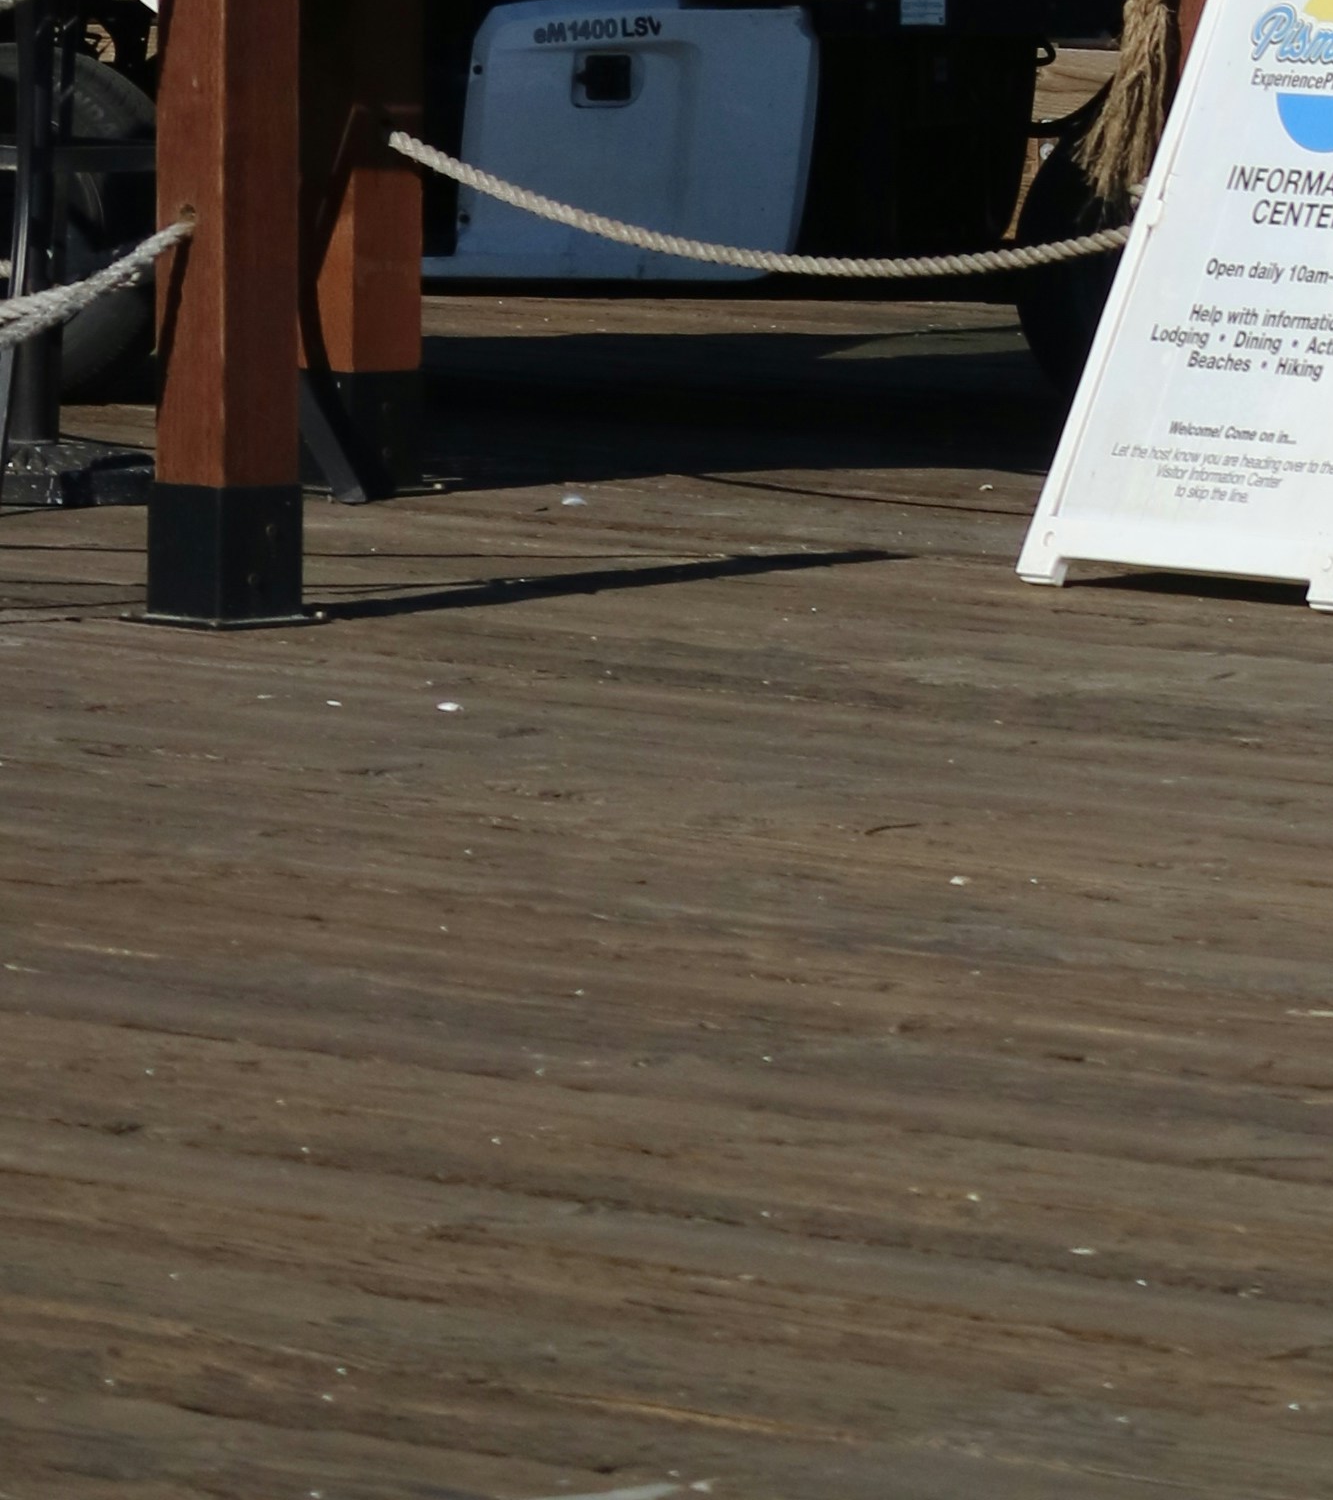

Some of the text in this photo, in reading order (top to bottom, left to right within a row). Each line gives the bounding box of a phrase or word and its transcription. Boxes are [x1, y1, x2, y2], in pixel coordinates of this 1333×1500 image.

[621, 15, 662, 38] LSV
[1206, 258, 1244, 280] Open
[1249, 261, 1285, 284] daily
[1189, 304, 1223, 325] Help
[1227, 307, 1259, 327] with
[1150, 324, 1210, 348] Lodging
[1233, 331, 1283, 355] Dining
[1187, 351, 1324, 382] Beaches Hiking
[1169, 420, 1222, 438] Welcome!
[1224, 426, 1257, 441] Come
[1259, 431, 1275, 443] on
[1111, 442, 1131, 457] Let
[1132, 445, 1148, 459] the
[1149, 447, 1171, 461] host
[1172, 448, 1201, 464] know
[1202, 454, 1220, 467] you
[1221, 455, 1239, 467] are
[1240, 453, 1280, 473] heading
[1282, 460, 1306, 471] over
[1307, 460, 1318, 473] to
[1156, 464, 1188, 480] Visitor
[1188, 466, 1246, 486] Information
[1174, 484, 1186, 498] to
[1186, 486, 1209, 502] skip
[1210, 488, 1228, 500] the
